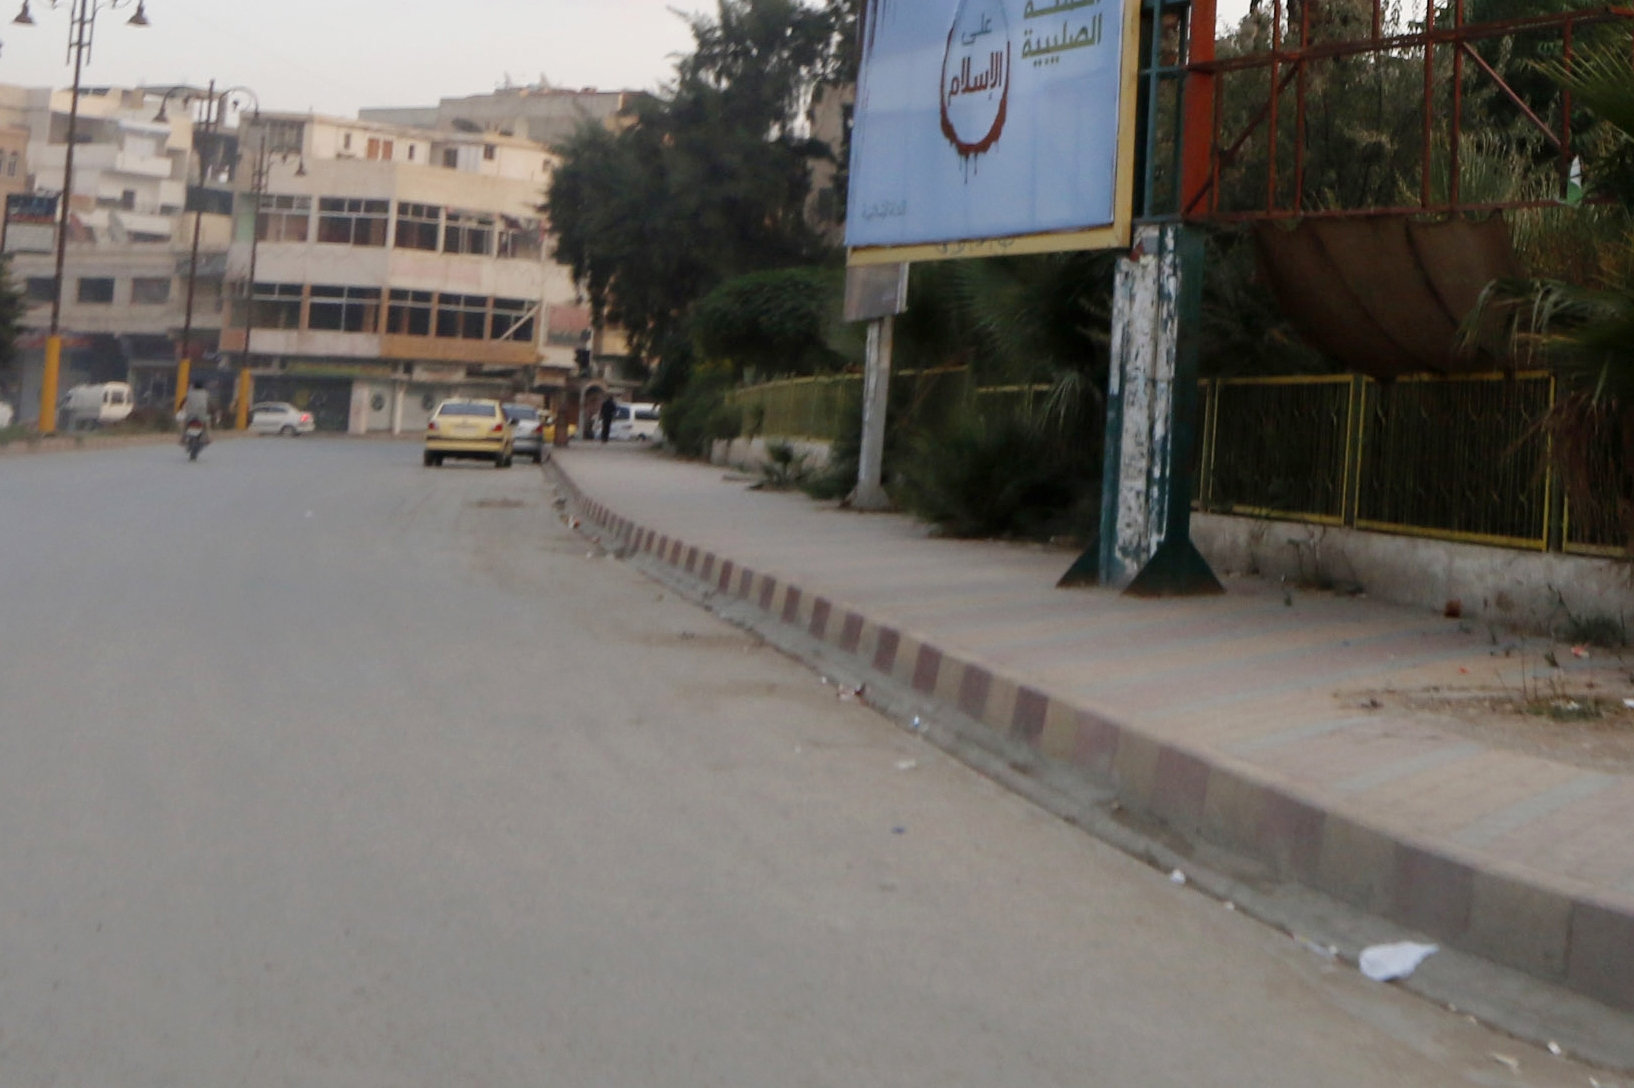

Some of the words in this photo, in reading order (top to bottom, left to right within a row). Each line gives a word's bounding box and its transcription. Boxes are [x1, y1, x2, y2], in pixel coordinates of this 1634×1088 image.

[962, 14, 992, 46] على
[1022, 13, 1102, 67] الصليبية
[948, 52, 1003, 106] الإسلام
